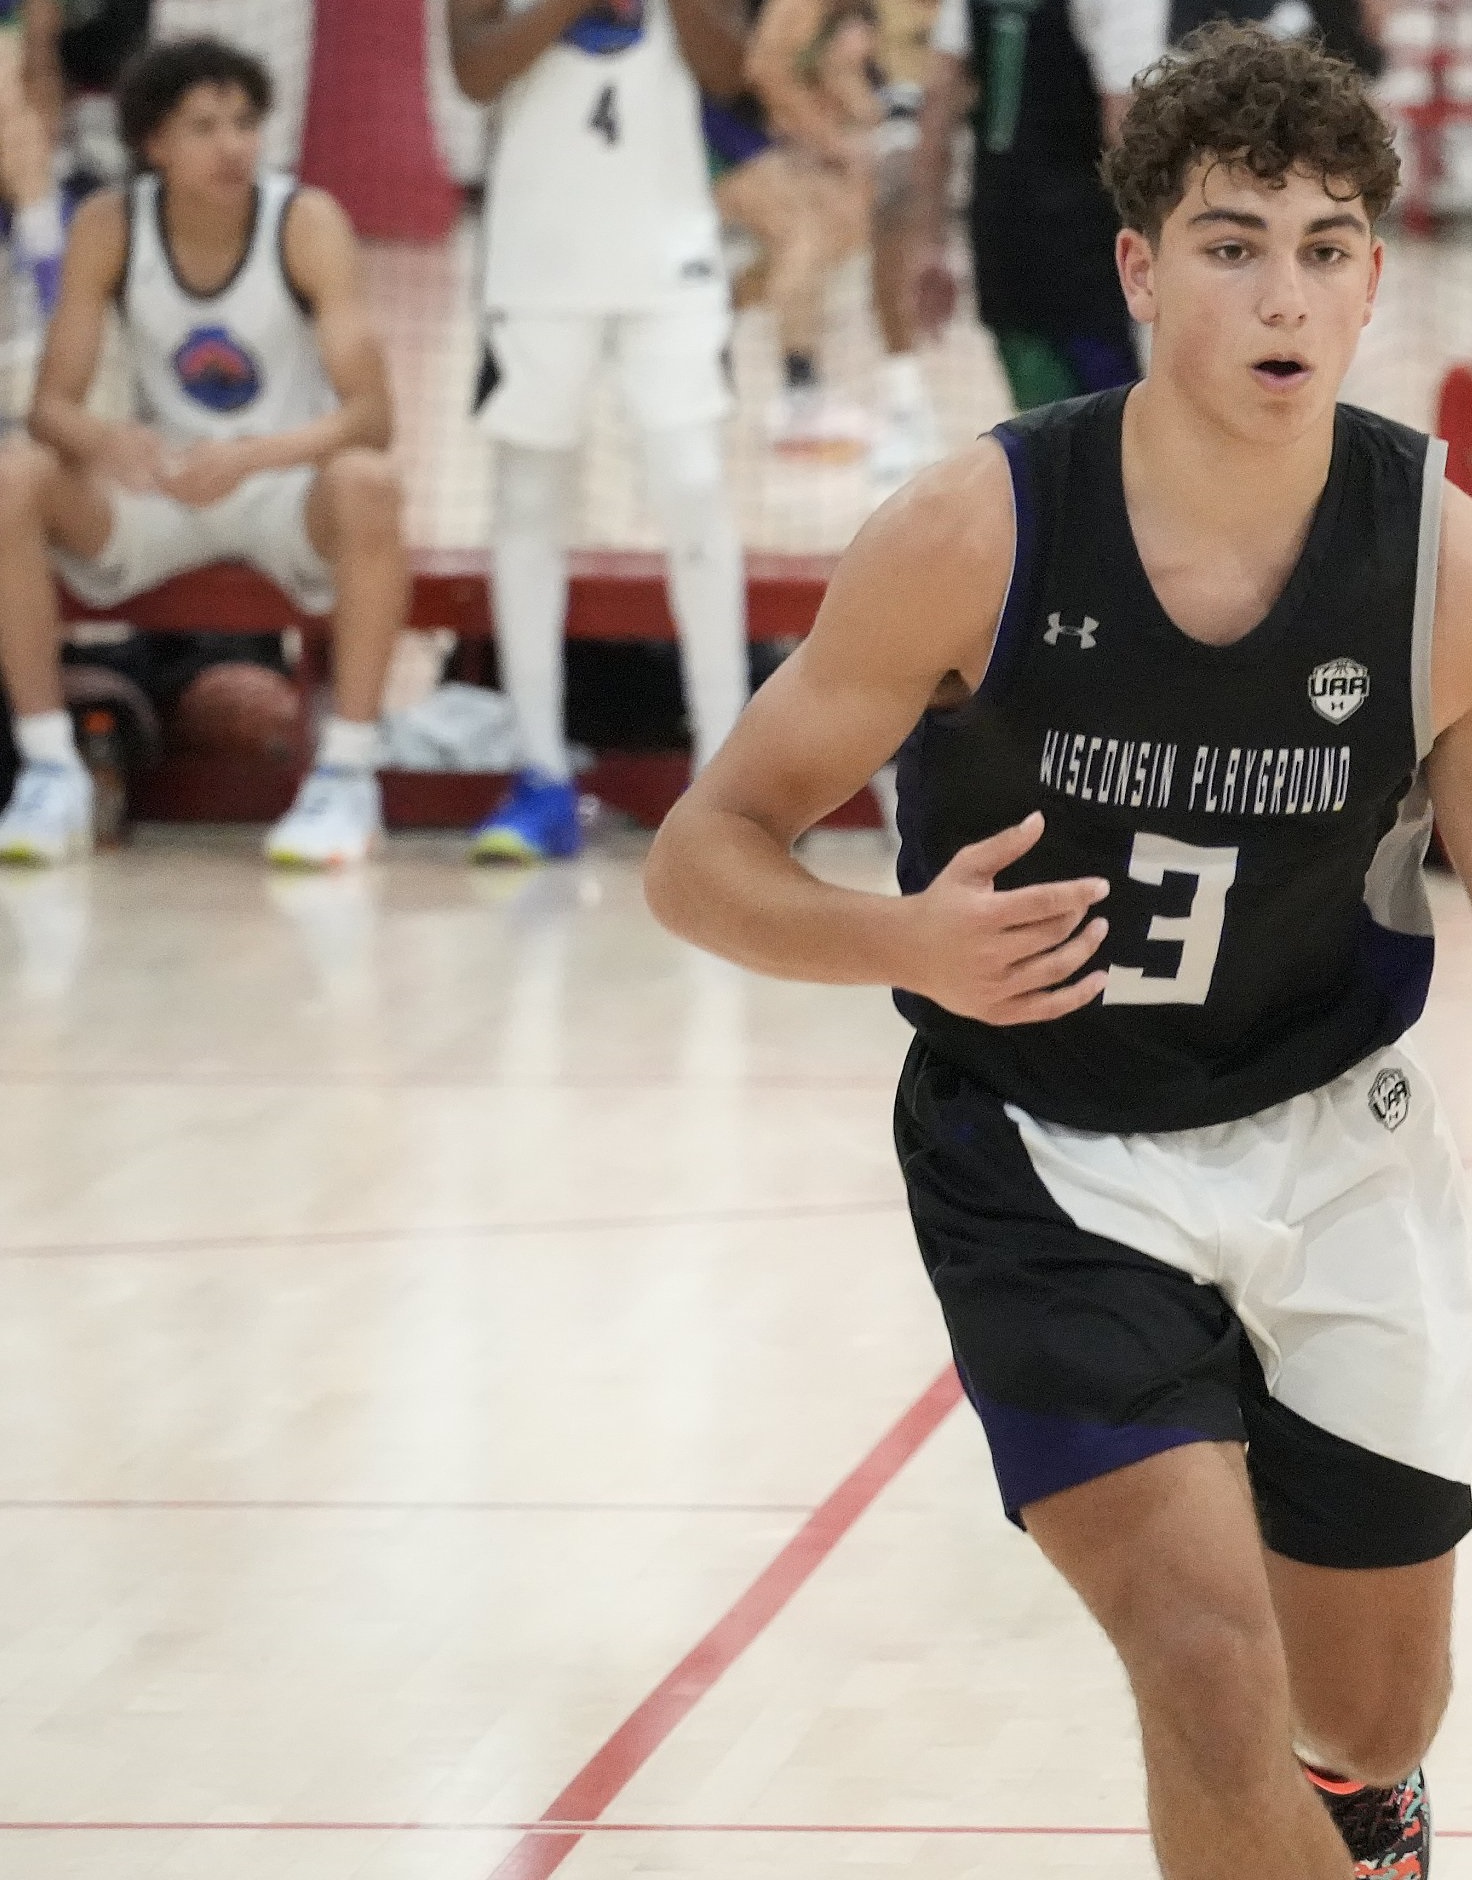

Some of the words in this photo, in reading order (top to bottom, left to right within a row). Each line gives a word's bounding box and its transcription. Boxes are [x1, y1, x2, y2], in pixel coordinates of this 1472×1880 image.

[588, 84, 619, 147] 4
[1310, 676, 1368, 698] UAA
[1040, 729, 1178, 810] WISCONSIN
[1188, 745, 1351, 816] PLAYGROUND
[1102, 831, 1239, 1006] 3
